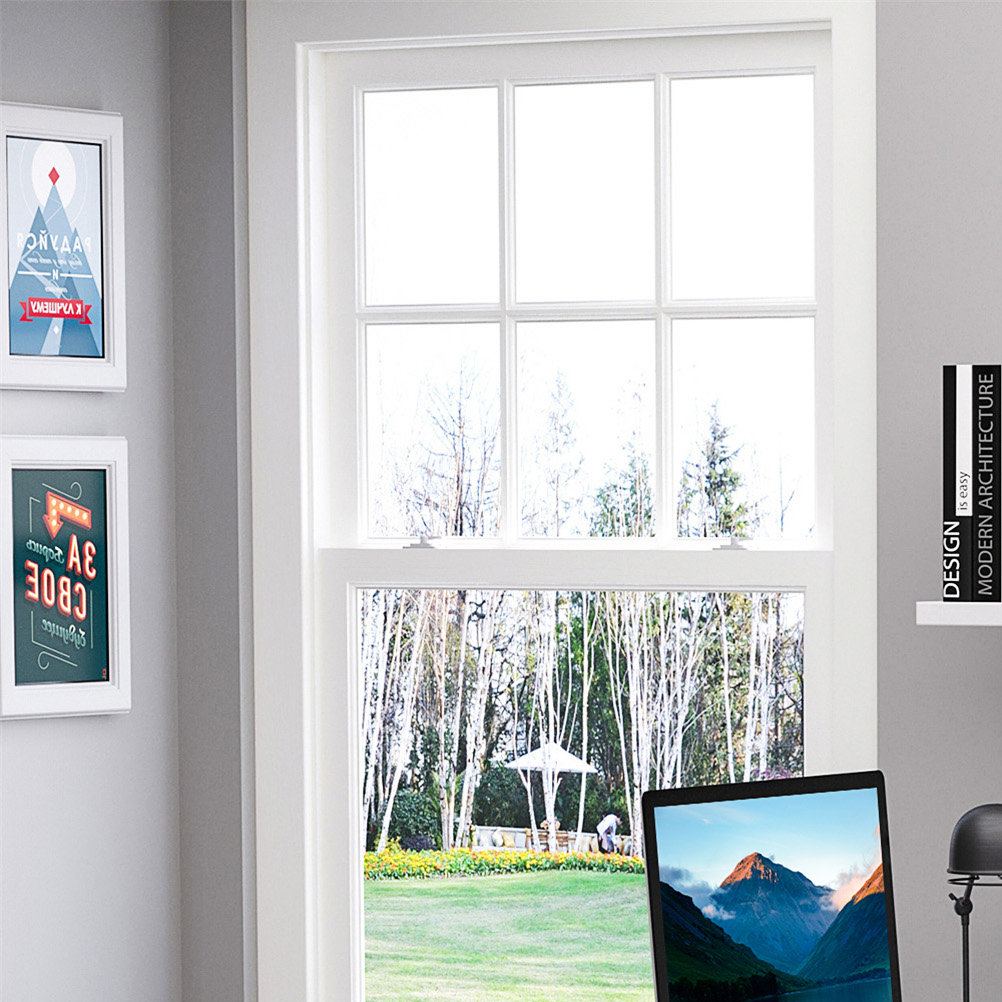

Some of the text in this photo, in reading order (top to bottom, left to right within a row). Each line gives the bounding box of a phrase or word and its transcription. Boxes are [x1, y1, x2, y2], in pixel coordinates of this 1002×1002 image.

[957, 471, 971, 511] is easy
[978, 373, 994, 595] MODERN ARCHITECTURE
[943, 521, 960, 598] DESIGN
